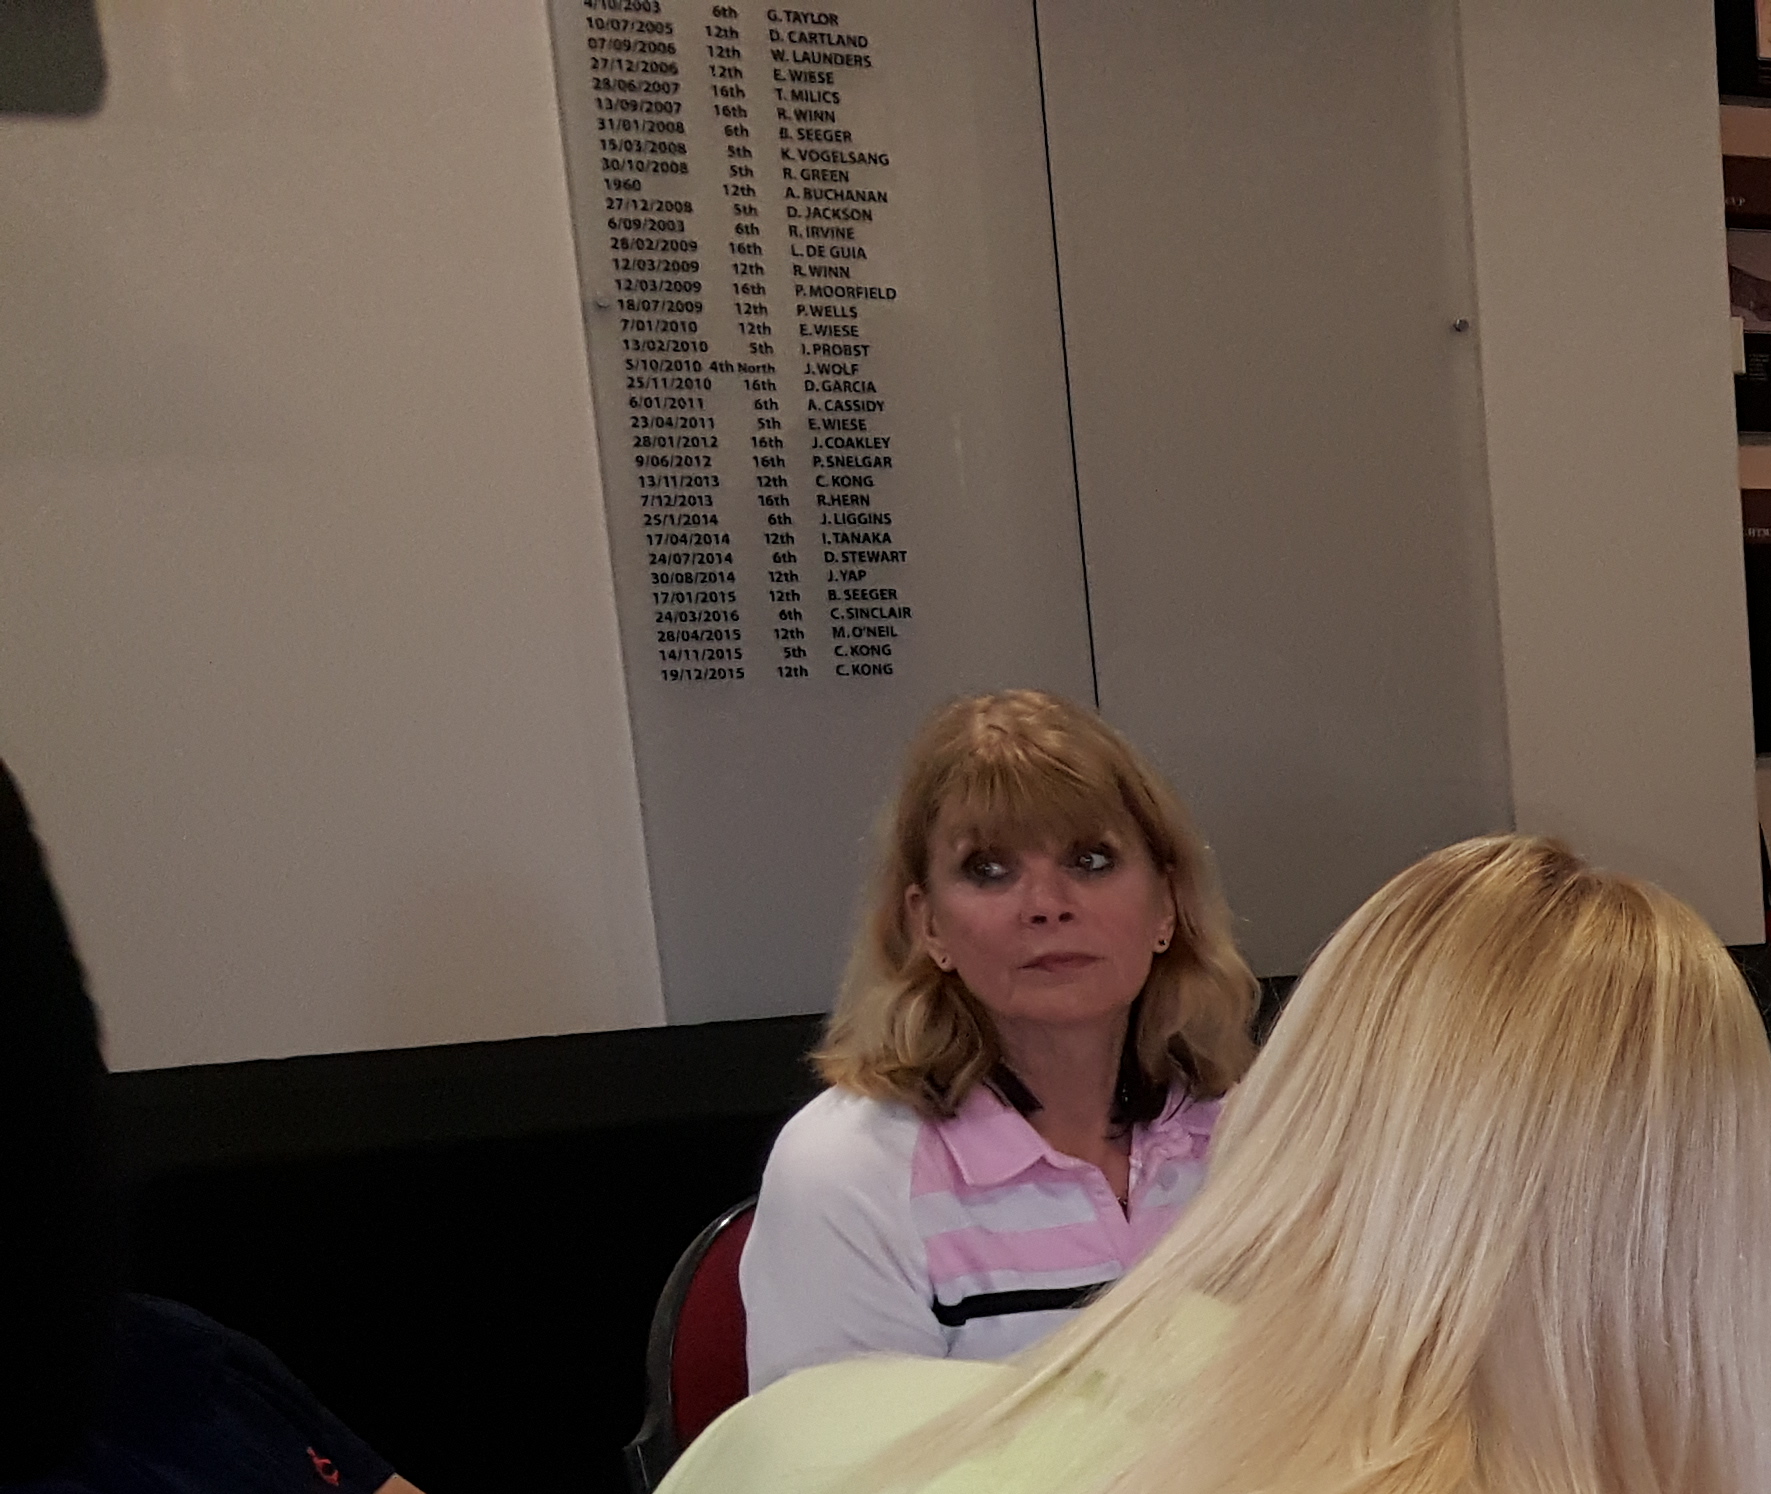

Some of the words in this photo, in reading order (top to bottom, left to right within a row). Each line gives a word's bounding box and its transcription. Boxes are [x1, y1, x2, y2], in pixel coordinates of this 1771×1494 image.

[711, 5, 738, 18] 6th
[704, 26, 739, 39] 12th
[706, 45, 740, 59] 12th
[708, 65, 743, 79] 12th
[711, 84, 745, 98] 16th
[713, 105, 747, 118] 16th
[723, 124, 749, 137] 6th
[727, 145, 752, 158] 5th
[729, 165, 753, 177] 5th
[722, 184, 756, 197] 12th
[733, 204, 758, 216] 5th
[734, 223, 759, 235] 6th
[728, 242, 762, 255] 16th
[731, 263, 764, 275] 12th
[732, 283, 766, 295] 16th
[733, 303, 768, 316] 12th
[738, 322, 771, 335] 12th
[748, 342, 774, 354] 5th
[708, 360, 734, 373] 4th
[743, 379, 776, 391] 16th
[753, 398, 779, 410] 6th
[757, 417, 781, 429] 5th
[750, 436, 783, 448] 16th
[752, 455, 785, 467] 16th
[756, 475, 787, 487] 12th
[757, 494, 789, 506] 16th
[767, 513, 792, 525] 6th
[763, 532, 794, 544] 12th
[772, 551, 796, 563] 6th
[767, 570, 798, 582] 12th
[768, 590, 800, 602] 12th
[778, 608, 802, 621] 6th
[773, 628, 804, 640] 12th
[783, 646, 806, 658] 5th
[777, 665, 808, 677] 12th
